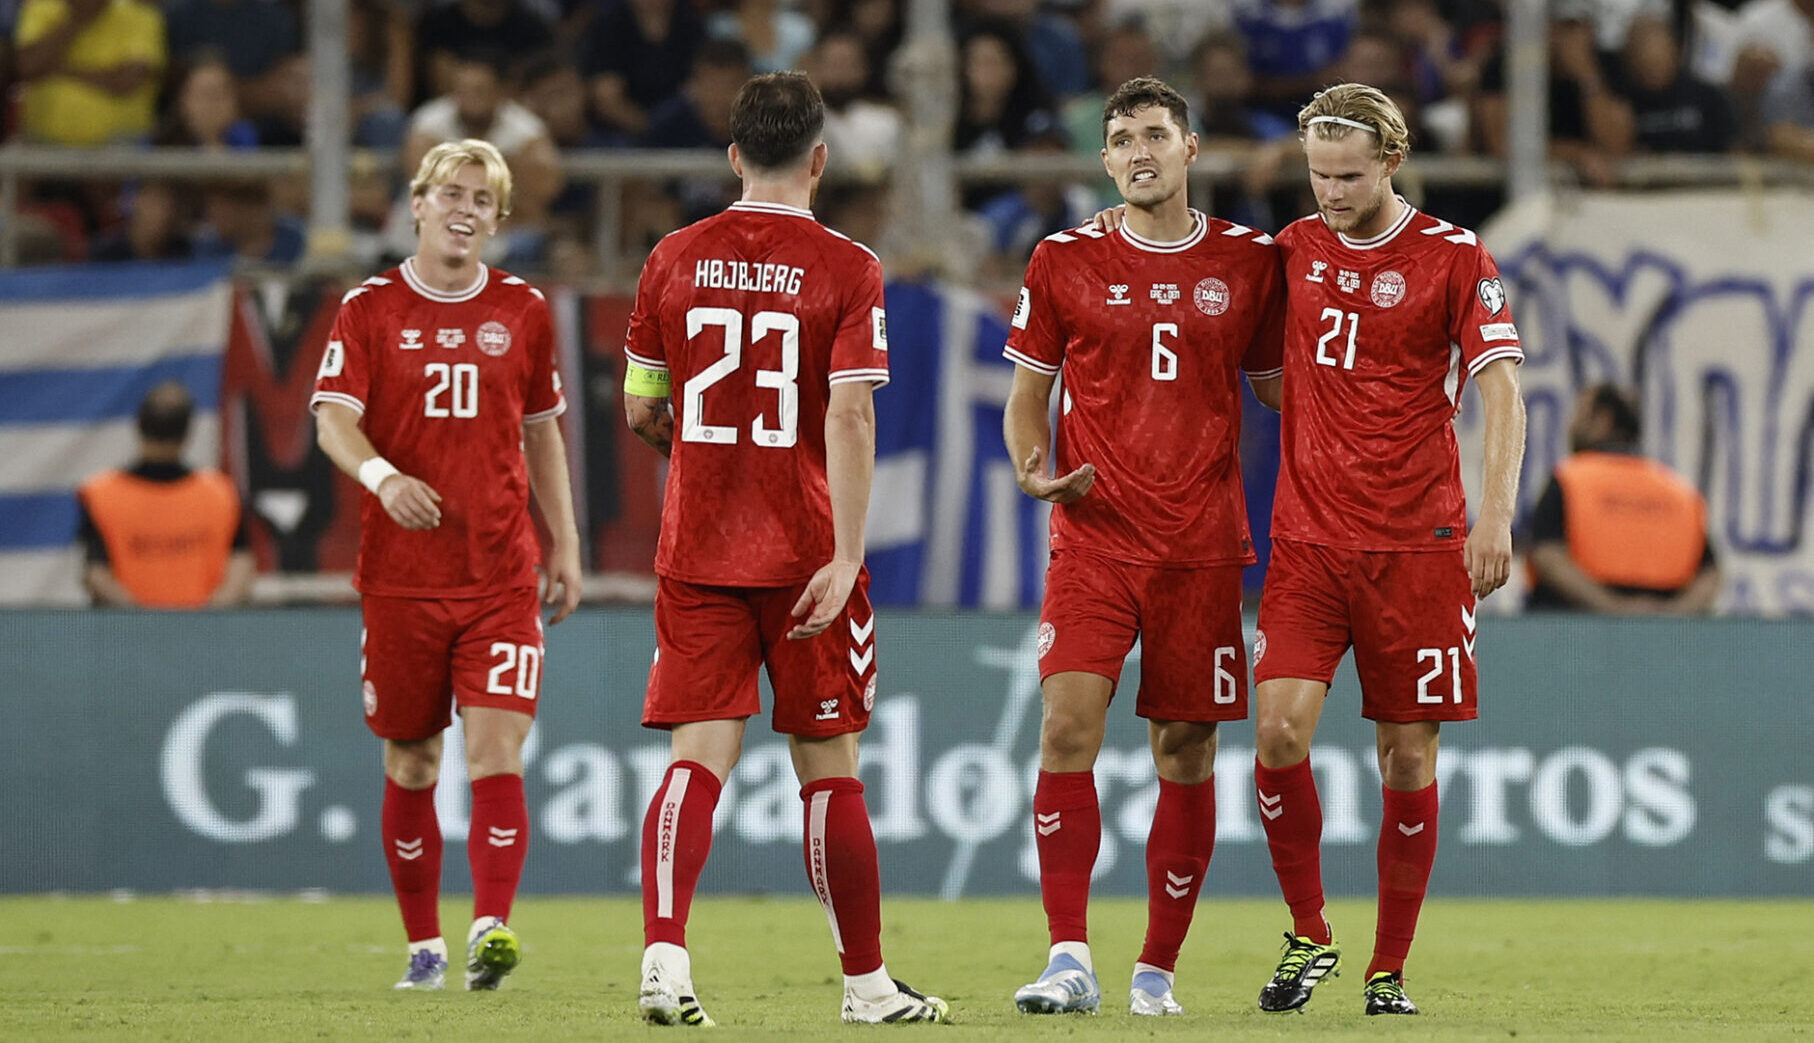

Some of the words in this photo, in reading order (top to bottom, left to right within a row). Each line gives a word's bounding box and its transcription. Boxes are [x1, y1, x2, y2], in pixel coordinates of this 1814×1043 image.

[695, 259, 805, 296] HØJBJERG
[1201, 288, 1223, 303] DBU
[1151, 322, 1178, 380] 6
[1316, 307, 1359, 370] 21
[424, 362, 478, 418] 20
[682, 307, 799, 448] 23
[486, 642, 540, 700] 20
[1213, 646, 1236, 704] 6
[1417, 646, 1462, 704] 21
[158, 690, 358, 843] G.
[661, 802, 675, 862] DANMARK
